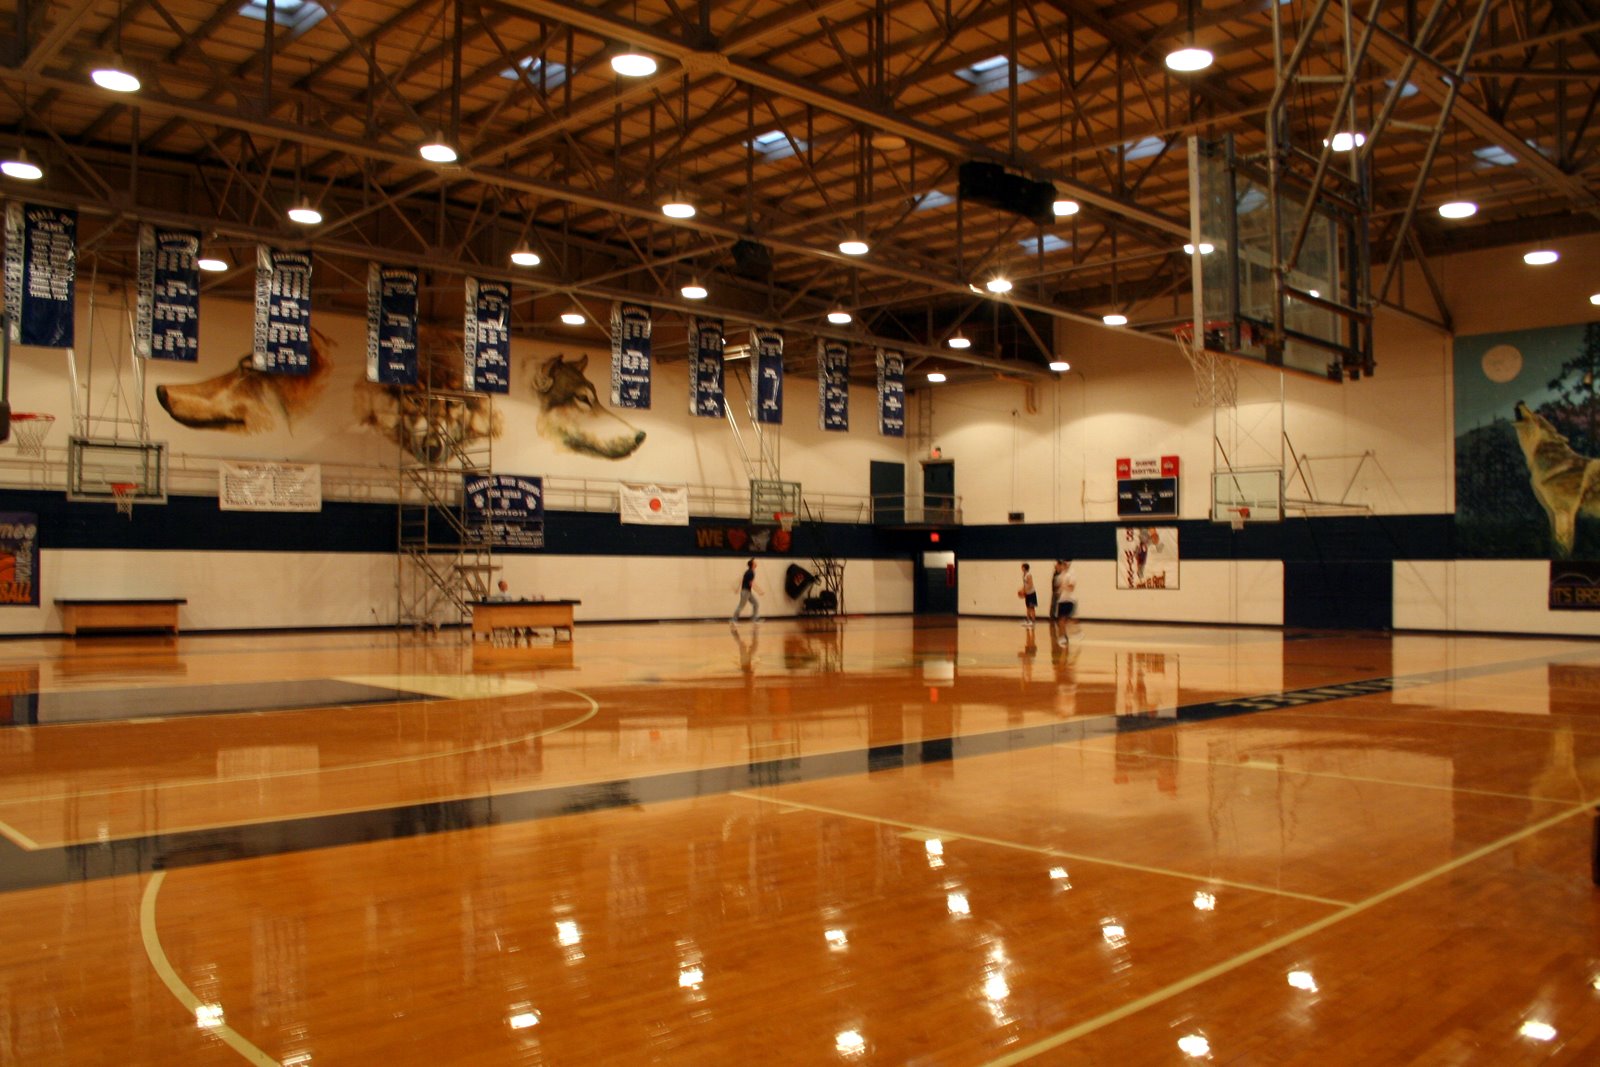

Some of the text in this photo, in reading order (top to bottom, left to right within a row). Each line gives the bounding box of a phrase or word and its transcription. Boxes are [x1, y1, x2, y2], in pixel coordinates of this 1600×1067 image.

[5, 227, 22, 322] BASKETBALL
[137, 250, 153, 340] GIRLS TENNIS
[255, 268, 270, 353] BOYS TENNIS
[367, 289, 380, 359] SOFTBALL
[465, 300, 477, 367] FOOTBALL
[697, 528, 723, 549] WE
